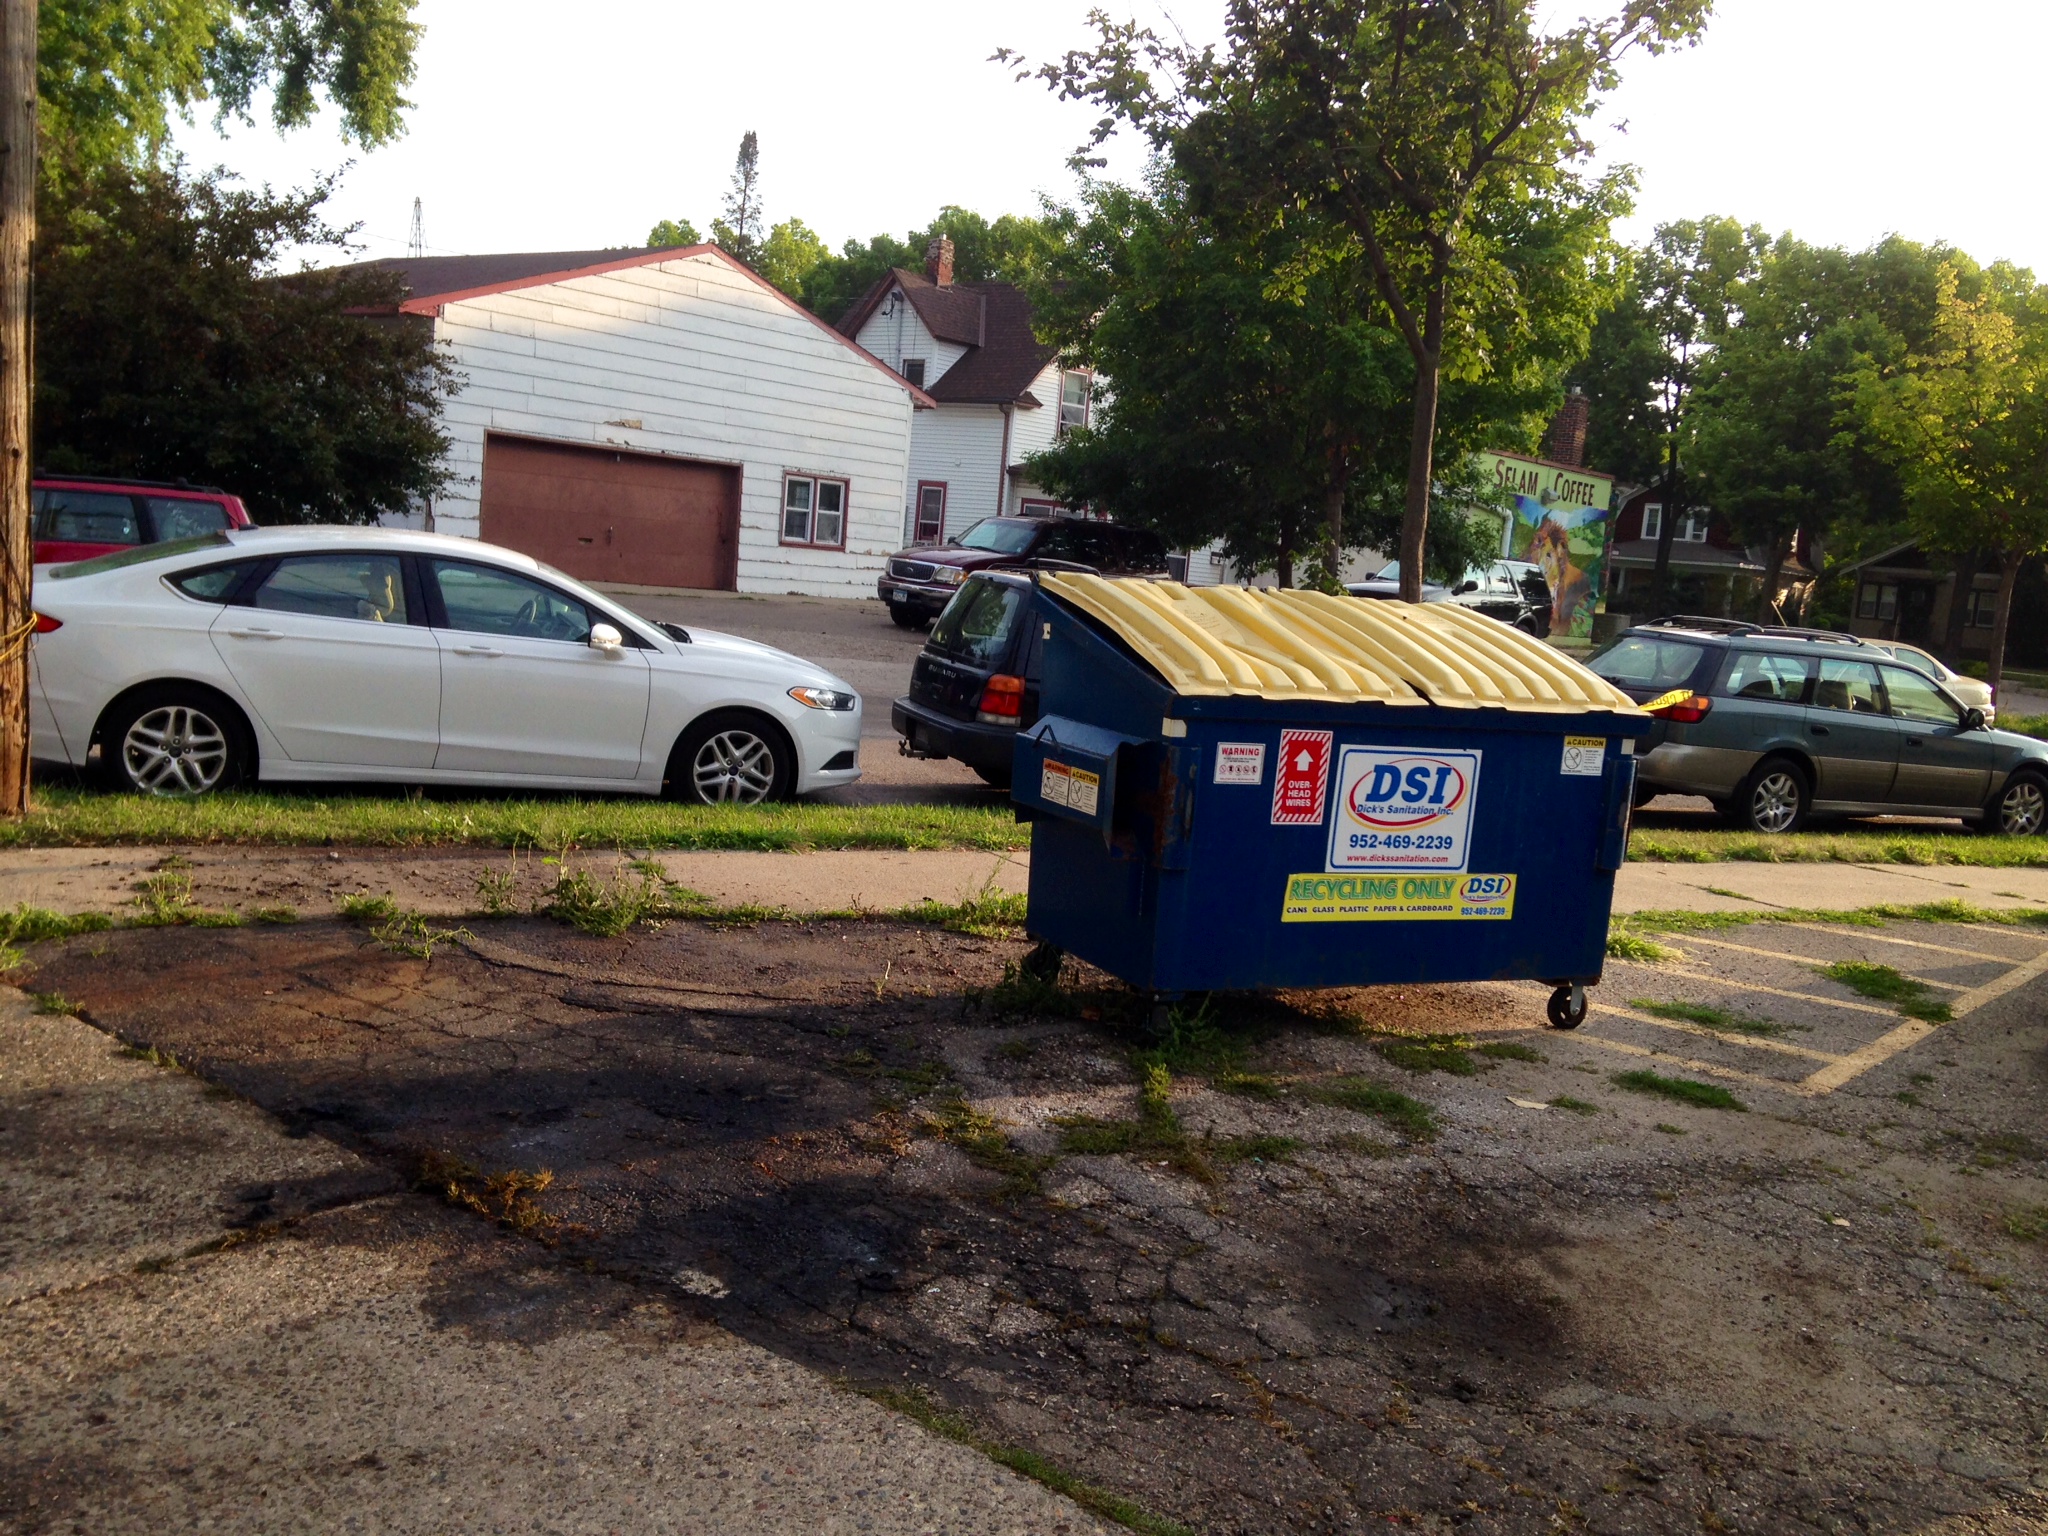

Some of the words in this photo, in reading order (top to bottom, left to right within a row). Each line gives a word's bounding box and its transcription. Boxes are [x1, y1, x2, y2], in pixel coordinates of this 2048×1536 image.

[1554, 472, 1595, 506] COFFEE
[1572, 738, 1604, 746] CAUTION
[1221, 747, 1260, 756] WARNING
[1075, 771, 1098, 784] CAUTION
[1288, 780, 1313, 788] OVER-
[1365, 764, 1453, 804] DSI
[1287, 789, 1311, 797] HEAD
[1285, 799, 1311, 807] WIRES
[1356, 804, 1384, 813] Dick's
[1387, 805, 1434, 815] Sanitation
[1437, 807, 1454, 815] Inc.
[1346, 854, 1449, 863] www.dickssanitation.com
[1289, 878, 1398, 900] RECYCLING
[1402, 878, 1457, 899] ONLY
[1468, 877, 1504, 893] DSI
[1461, 907, 1505, 915] 952-469-2239
